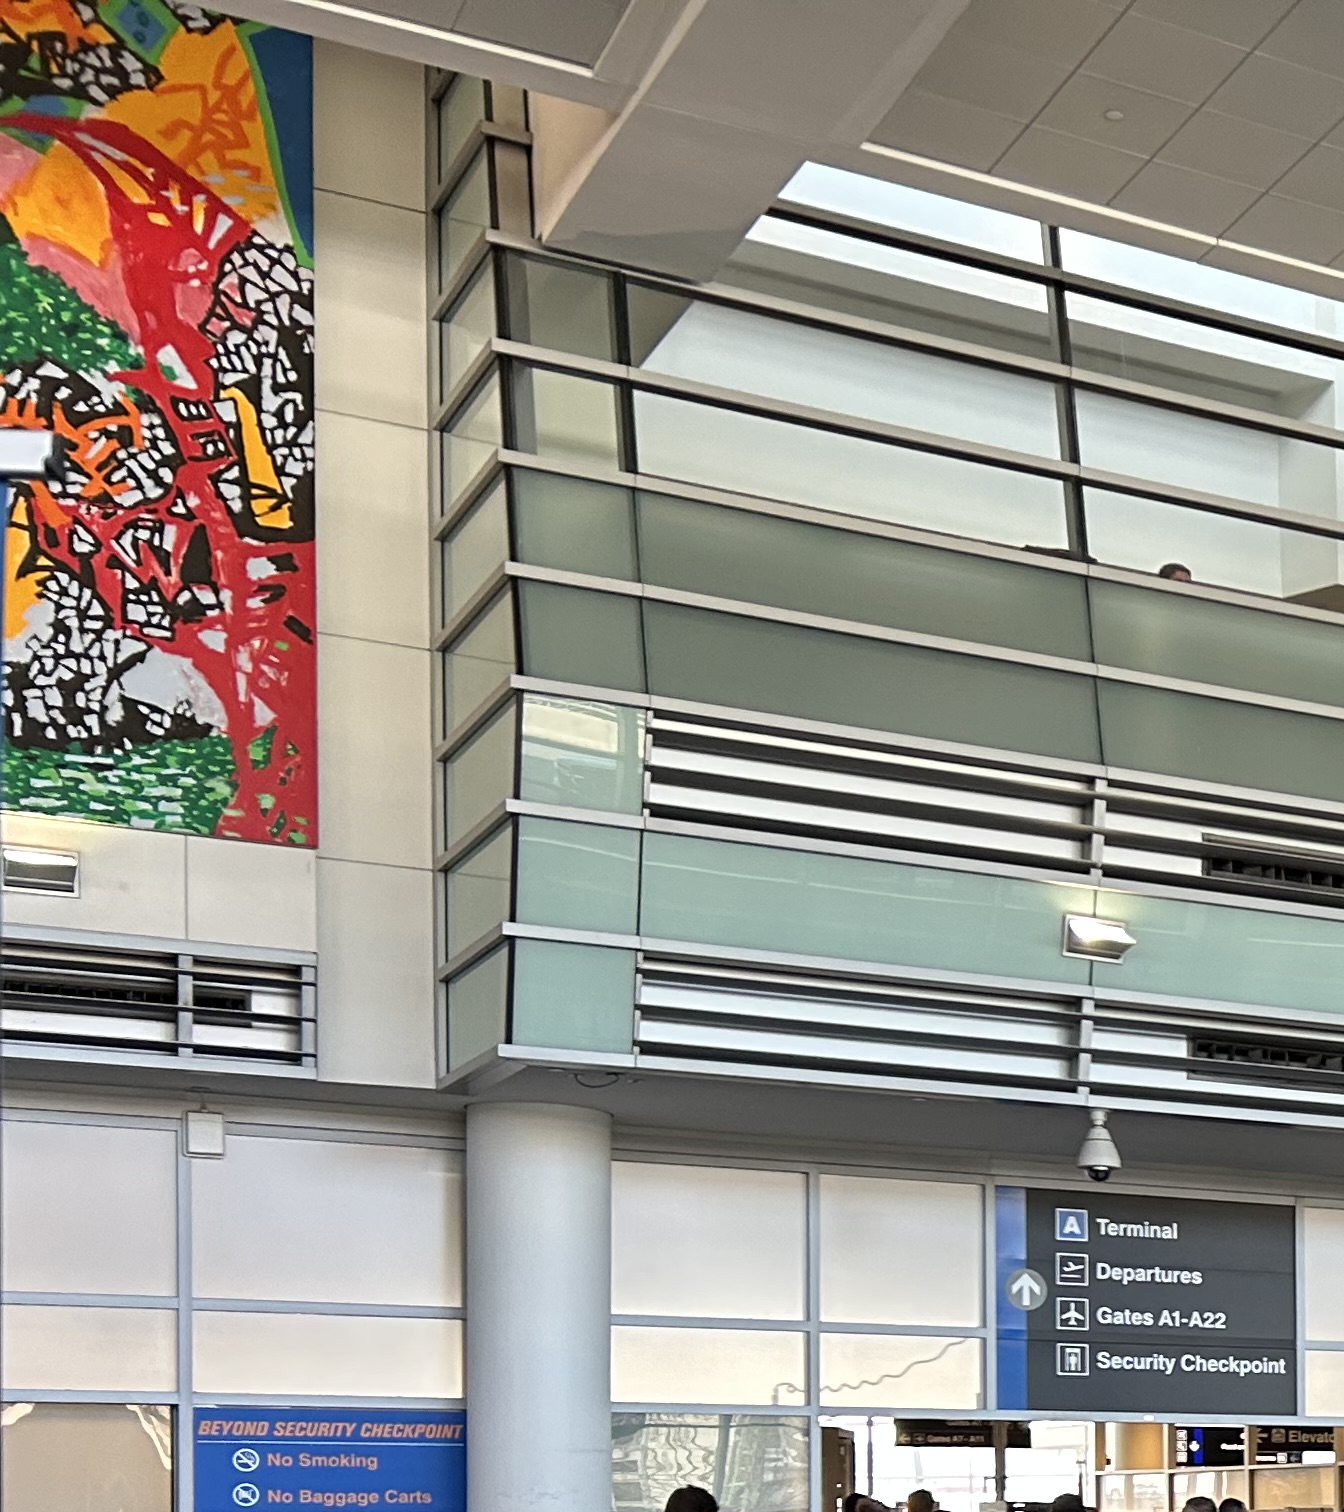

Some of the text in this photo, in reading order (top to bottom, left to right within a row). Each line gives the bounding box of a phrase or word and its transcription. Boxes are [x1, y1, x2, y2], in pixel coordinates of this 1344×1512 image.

[1063, 1216, 1179, 1240] A Terminal
[1095, 1263, 1204, 1286] Departures
[1095, 1306, 1227, 1330] Gates A1-A22
[1095, 1351, 1287, 1377] Security Checkpoint
[198, 1420, 463, 1440] BEYOND SECURITY CHECKPOINT
[267, 1453, 379, 1471] No Smoking
[267, 1489, 432, 1507] No Baggage Carts
